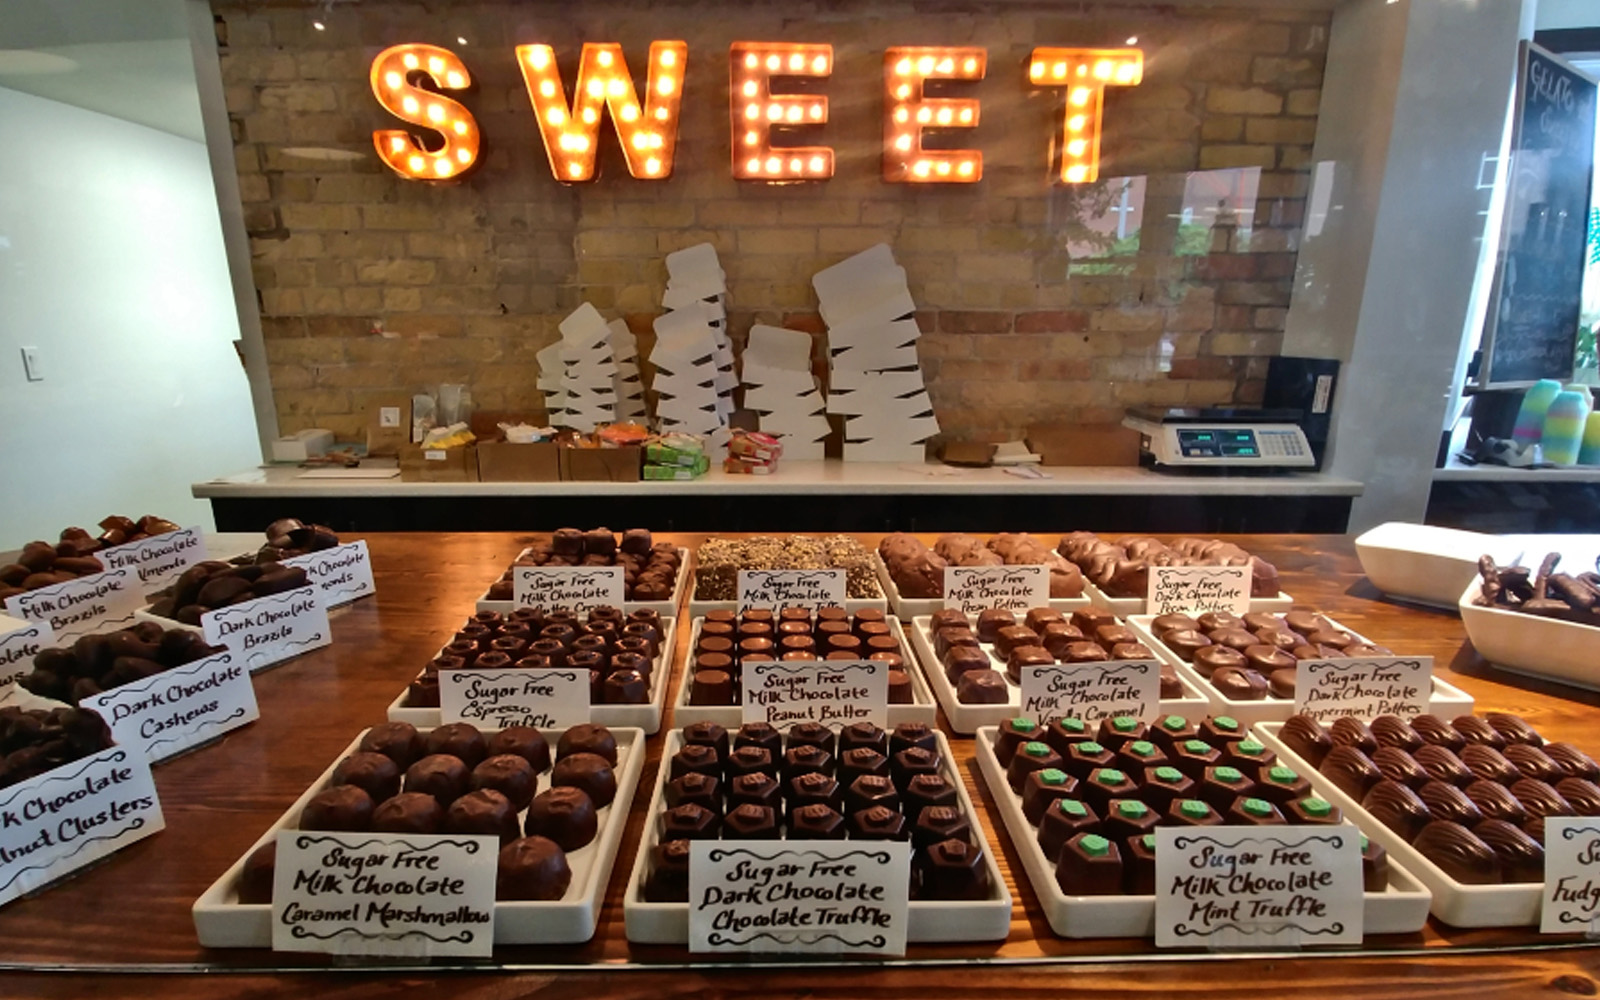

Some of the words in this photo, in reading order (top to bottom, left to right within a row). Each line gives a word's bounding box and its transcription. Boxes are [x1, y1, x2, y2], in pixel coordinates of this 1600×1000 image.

[370, 40, 1145, 183] SWEET
[109, 553, 141, 570] Milk
[141, 536, 198, 563] Chocolate
[318, 552, 365, 577] Chocolate
[320, 572, 354, 591] monds
[530, 577, 567, 592] Sugar
[570, 577, 596, 588] Free
[762, 577, 795, 590] Sugar
[796, 576, 820, 588] Free
[948, 588, 975, 601] Milk
[980, 586, 1034, 599] Chocolate
[962, 575, 997, 590] Sugar
[1001, 575, 1026, 585] Free
[1156, 576, 1192, 595] Sugar
[1197, 577, 1222, 590] Free
[22, 603, 57, 620] Milk
[58, 580, 125, 610] Chocolate
[520, 592, 547, 605] Milk
[550, 587, 609, 601] Chocolate
[743, 588, 773, 603] Milk
[773, 588, 831, 600] Chocolate
[1155, 591, 1184, 603] Dark
[1186, 588, 1241, 600] Chocolate
[1160, 601, 1190, 614] Pecan
[50, 603, 108, 631] Brazils
[217, 617, 255, 640] Dark
[257, 600, 316, 627] Chocolate
[242, 625, 293, 652] Brazils
[0, 643, 40, 666] olate
[464, 680, 520, 705] Sugar
[523, 680, 555, 697] Free
[763, 673, 810, 693] Sugar
[816, 671, 847, 685] Free
[1047, 674, 1096, 698] Sugar
[1098, 671, 1129, 686] Free
[1319, 671, 1368, 691] Sugar
[1370, 668, 1402, 683] Free
[111, 693, 167, 727] Dark
[167, 666, 242, 703] Chocolate
[748, 689, 786, 706] Milk
[789, 686, 870, 701] Chocolate
[1025, 696, 1061, 712] Milk
[1070, 686, 1142, 705] Chocolate
[1303, 687, 1342, 706] Dark
[1342, 684, 1418, 700] Chocolate
[140, 700, 220, 740] Cashews
[460, 700, 532, 721] Espresso
[495, 714, 556, 728] Truffle
[766, 705, 815, 723] Peanut
[818, 704, 872, 723] Butter
[1038, 708, 1082, 727] Vanlla
[23, 767, 134, 821] Chocolate
[0, 828, 54, 868] lnut
[58, 796, 153, 843] Clusters
[321, 847, 389, 880] Sugar
[392, 850, 441, 870] Free
[725, 861, 805, 887] Sugar
[808, 860, 857, 878] Free
[1189, 846, 1263, 879] Sugar
[1269, 846, 1313, 866] Free
[293, 869, 345, 896] Milk
[352, 875, 464, 896] Chocolate
[698, 886, 764, 910] Dark
[766, 881, 885, 903] Chocolate
[1171, 874, 1225, 900] Milk
[1228, 870, 1333, 895] Chocolate
[1551, 875, 1600, 912] Fudg
[281, 901, 360, 925] Caramel
[364, 901, 490, 928] Marshmallow
[712, 906, 813, 932] Chocolate
[815, 905, 892, 928] Truffle
[1188, 900, 1241, 926] Mint
[1248, 894, 1327, 919] Truffle
